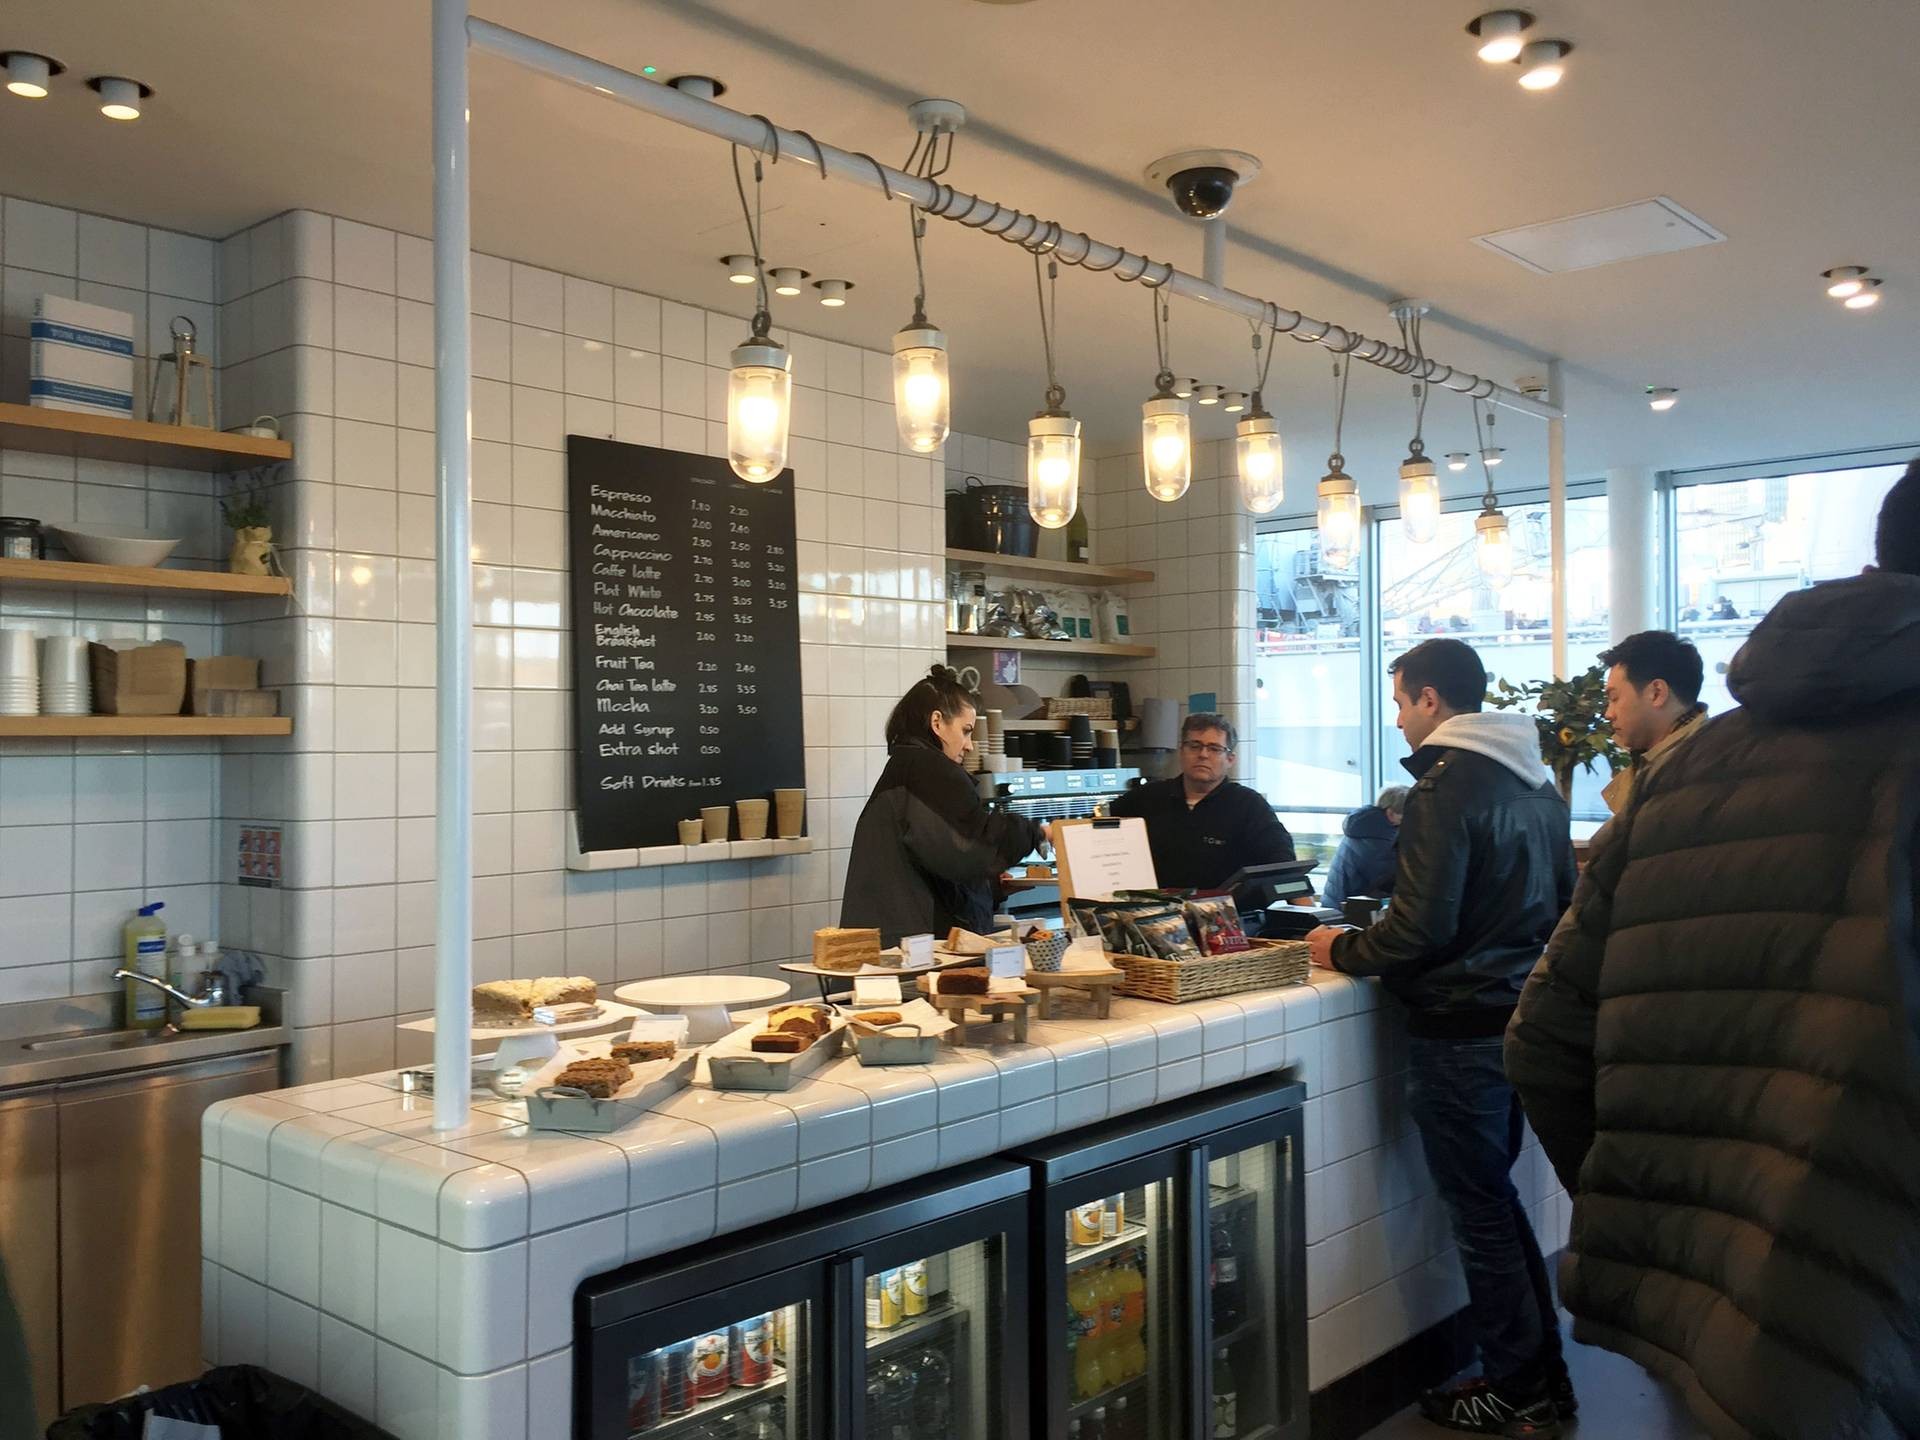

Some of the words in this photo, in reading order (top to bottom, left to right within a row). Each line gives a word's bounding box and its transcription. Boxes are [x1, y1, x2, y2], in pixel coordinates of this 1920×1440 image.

[590, 484, 652, 503] Espresso
[590, 503, 657, 523] Macchiato
[592, 523, 661, 541] Americano
[593, 543, 673, 562] Cappuccino
[594, 581, 620, 597] Flat
[627, 584, 662, 599] White
[593, 601, 614, 616] Hot
[619, 603, 679, 619] Chocolate
[595, 622, 640, 637] English
[596, 634, 657, 648] Breakfast
[595, 655, 629, 669] Fruit
[630, 656, 655, 670] Tea
[596, 679, 624, 692] Chai
[625, 678, 648, 692] Tea
[597, 697, 650, 713] Mocha
[598, 723, 626, 736] Add
[633, 723, 676, 739] Syrup
[599, 741, 643, 757] Extra
[647, 741, 680, 756] shot
[600, 775, 635, 791] Soft
[641, 775, 686, 789] Drinks
